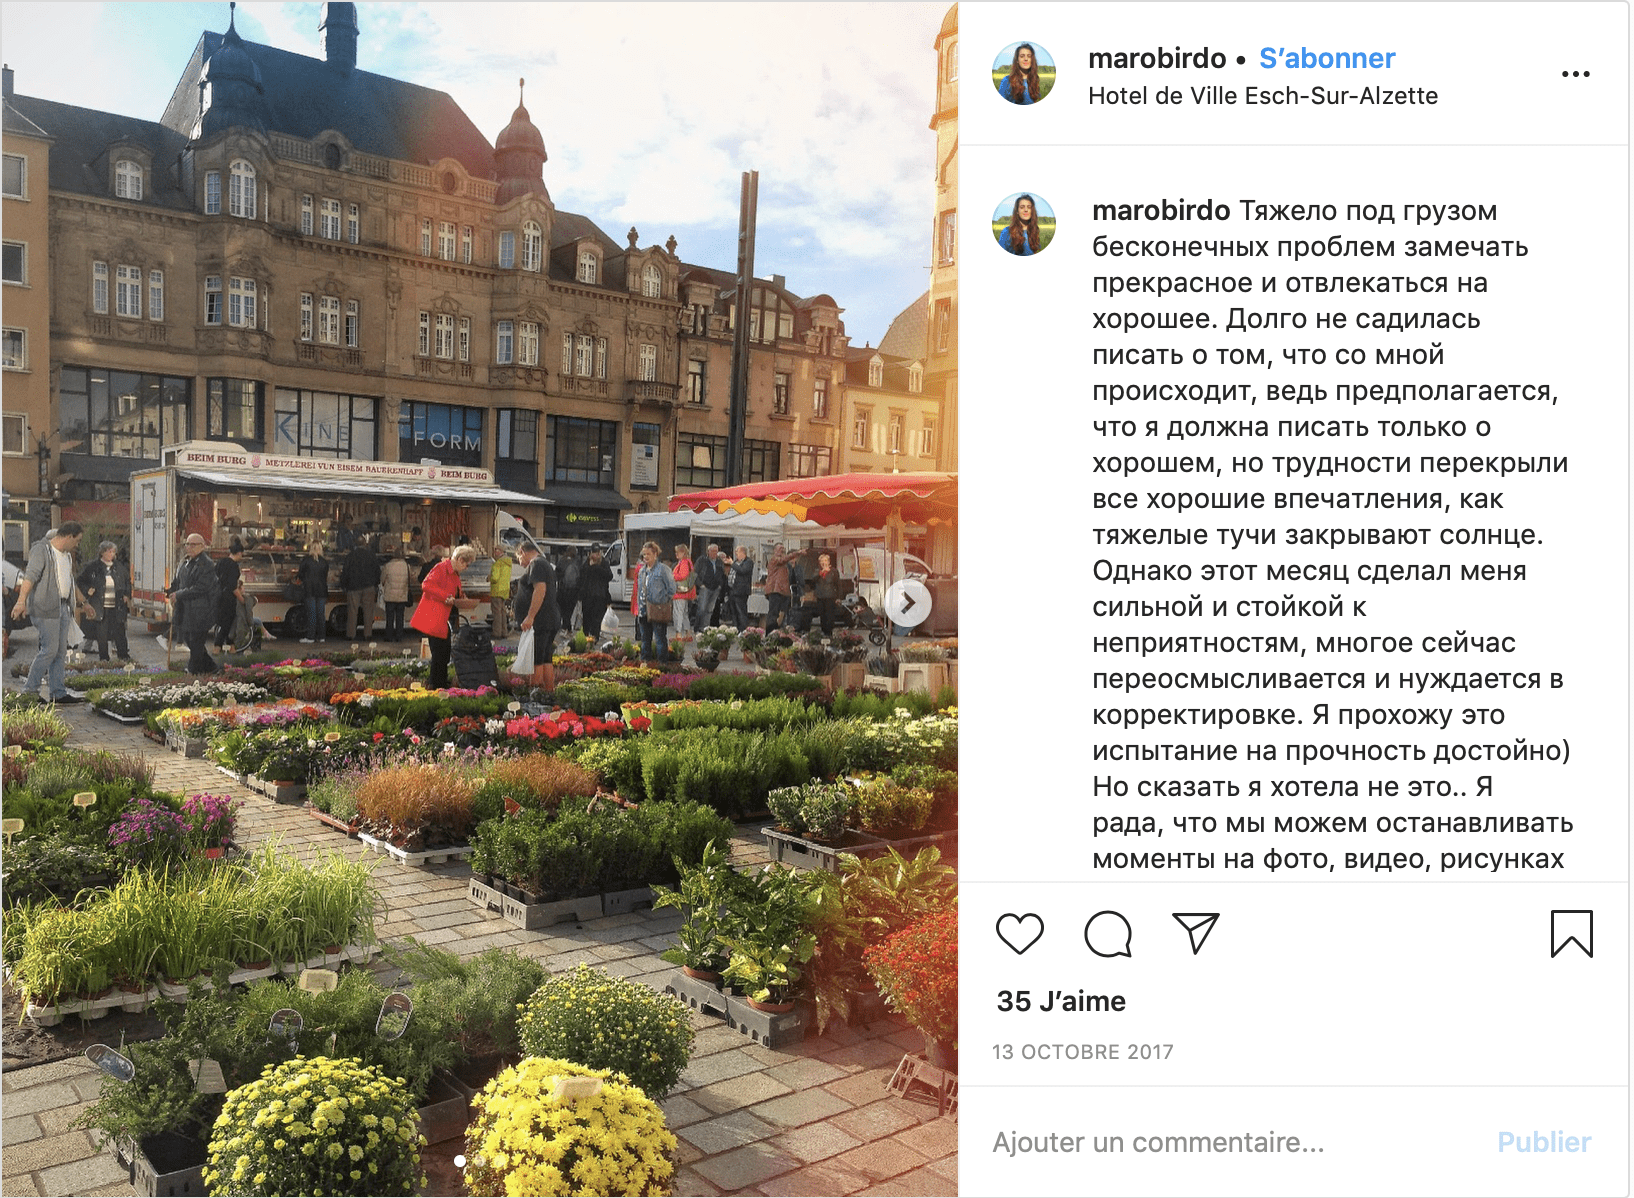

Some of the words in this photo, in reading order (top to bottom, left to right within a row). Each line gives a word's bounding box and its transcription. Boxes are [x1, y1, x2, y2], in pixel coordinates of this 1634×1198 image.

[274, 413, 350, 444] KINE
[414, 431, 481, 451] FORM
[187, 453, 215, 463] BEIM
[217, 455, 247, 465] BURG
[265, 459, 316, 470] METZLEREI
[317, 462, 335, 471] VUN
[440, 470, 463, 479] BEIM
[463, 471, 488, 480] BURG
